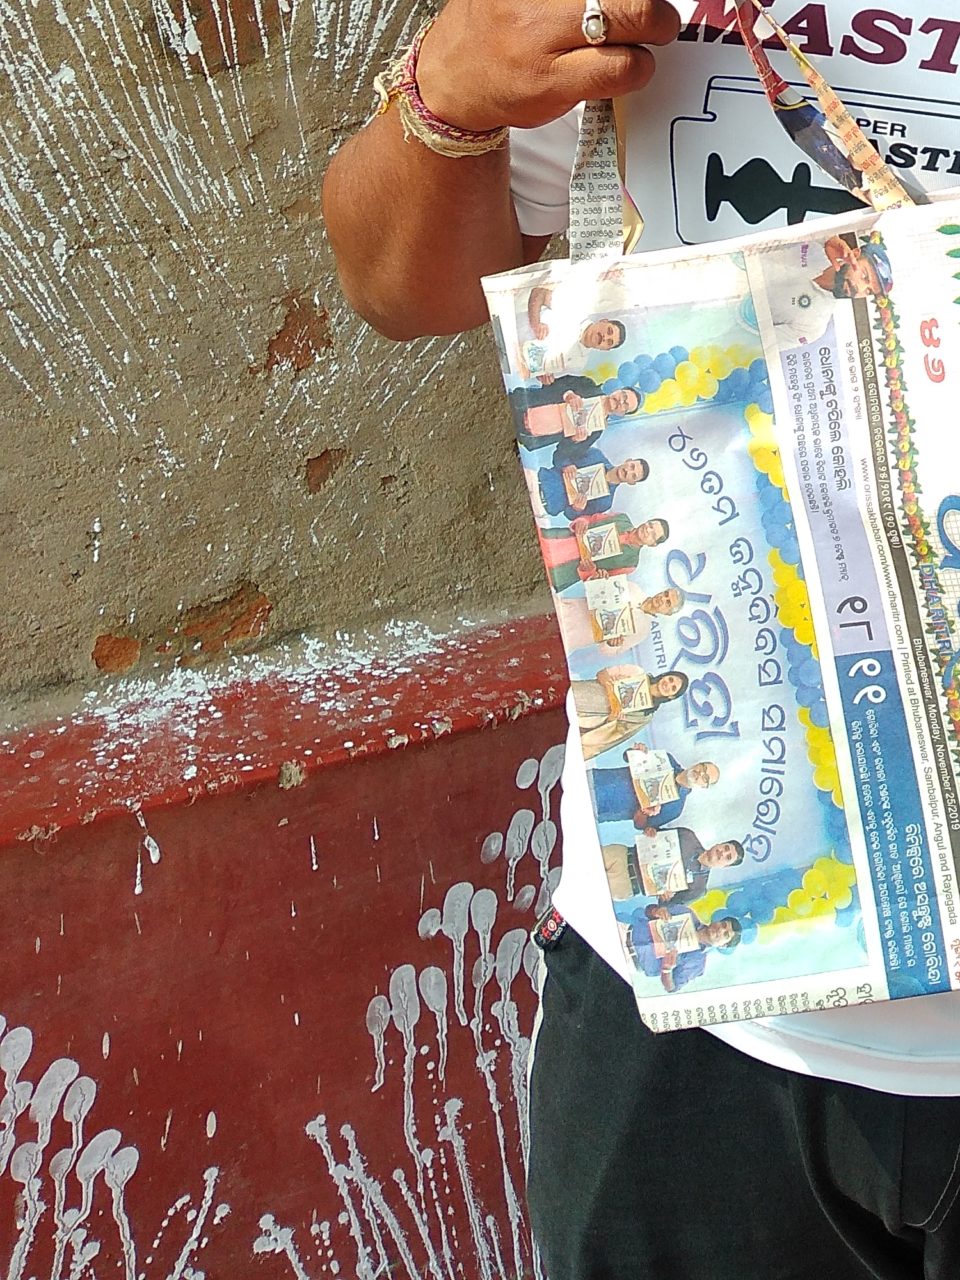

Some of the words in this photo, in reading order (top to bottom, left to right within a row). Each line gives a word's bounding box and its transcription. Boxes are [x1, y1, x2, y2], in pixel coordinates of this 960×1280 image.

[856, 118, 907, 138] PER
[817, 346, 837, 400] ଧୋନୀଙ୍କୁ
[824, 398, 843, 443] ଟପିଲେ
[831, 444, 853, 492] କୋହଲି
[728, 535, 784, 689] ଜନ୍ମଦିବସ
[918, 561, 954, 659] DHARITRI
[650, 618, 667, 669] ARITRI
[899, 650, 914, 685] Printed
[844, 655, 888, 709] ୧୧
[906, 686, 916, 696] at
[908, 697, 929, 765] Bhubaneswar,
[912, 637, 934, 702] Bhubaneswar,
[926, 703, 941, 742] Monday,
[934, 743, 952, 791] November
[944, 791, 960, 831] 25/2019
[743, 702, 789, 863] ସମାରୋହ
[922, 765, 939, 820] Sambalpur,
[932, 820, 946, 851] Angul
[937, 851, 949, 872] and
[940, 873, 958, 925] Rayagada
